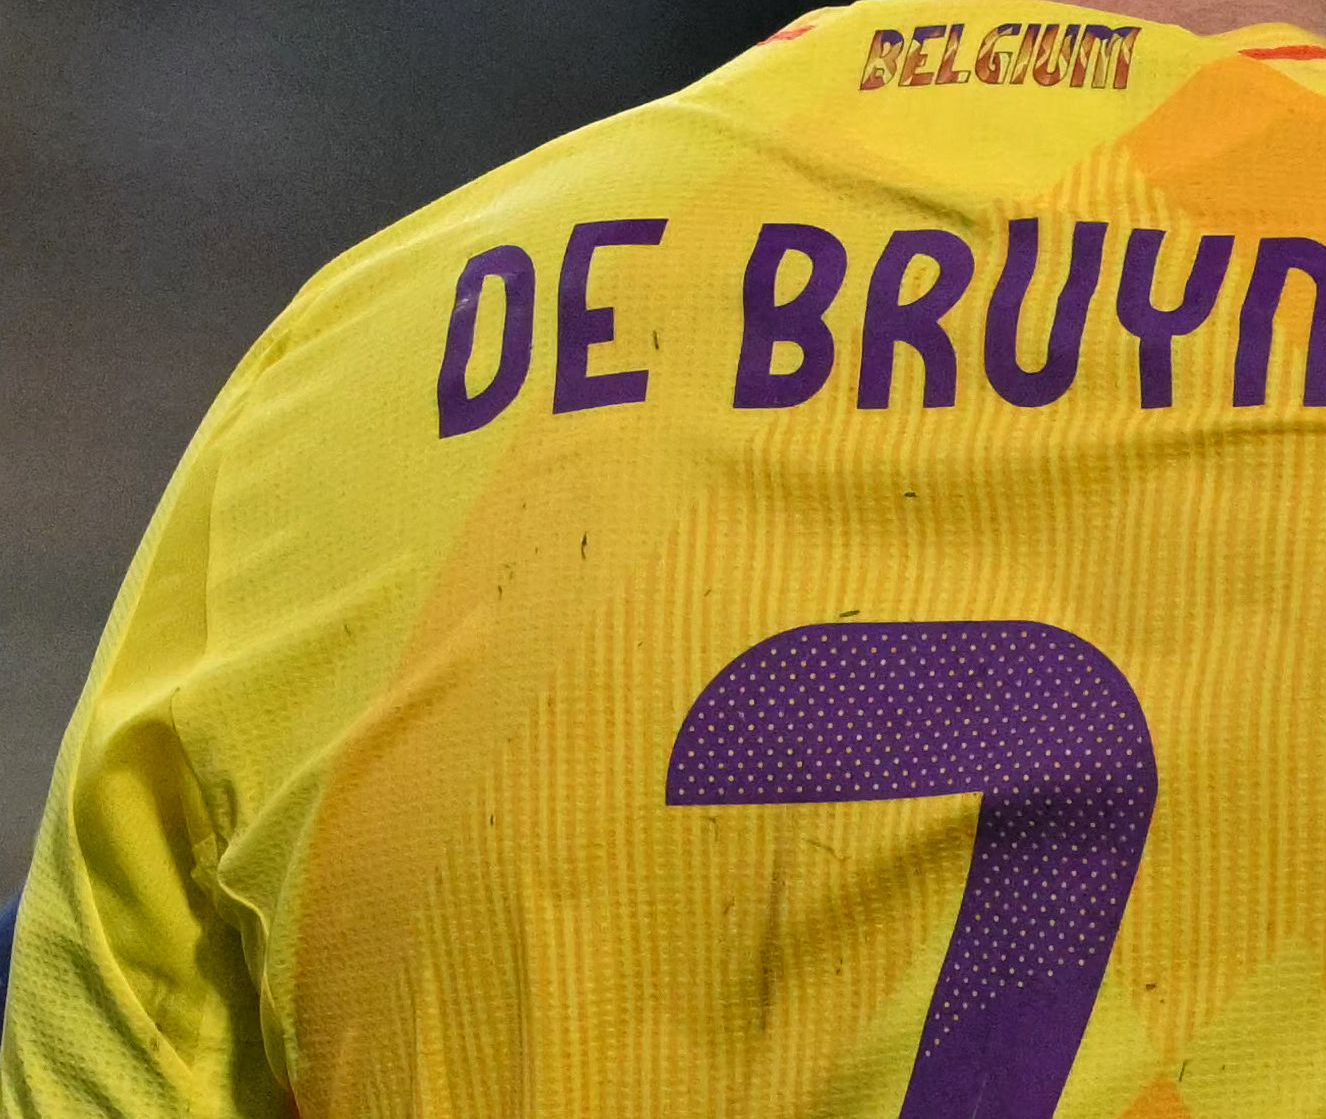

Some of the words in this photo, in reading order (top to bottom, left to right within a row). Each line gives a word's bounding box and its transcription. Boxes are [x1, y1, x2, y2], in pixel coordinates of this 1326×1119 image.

[860, 23, 1142, 90] BELGIUM
[439, 219, 669, 438] DE
[665, 620, 1158, 1119] 7
